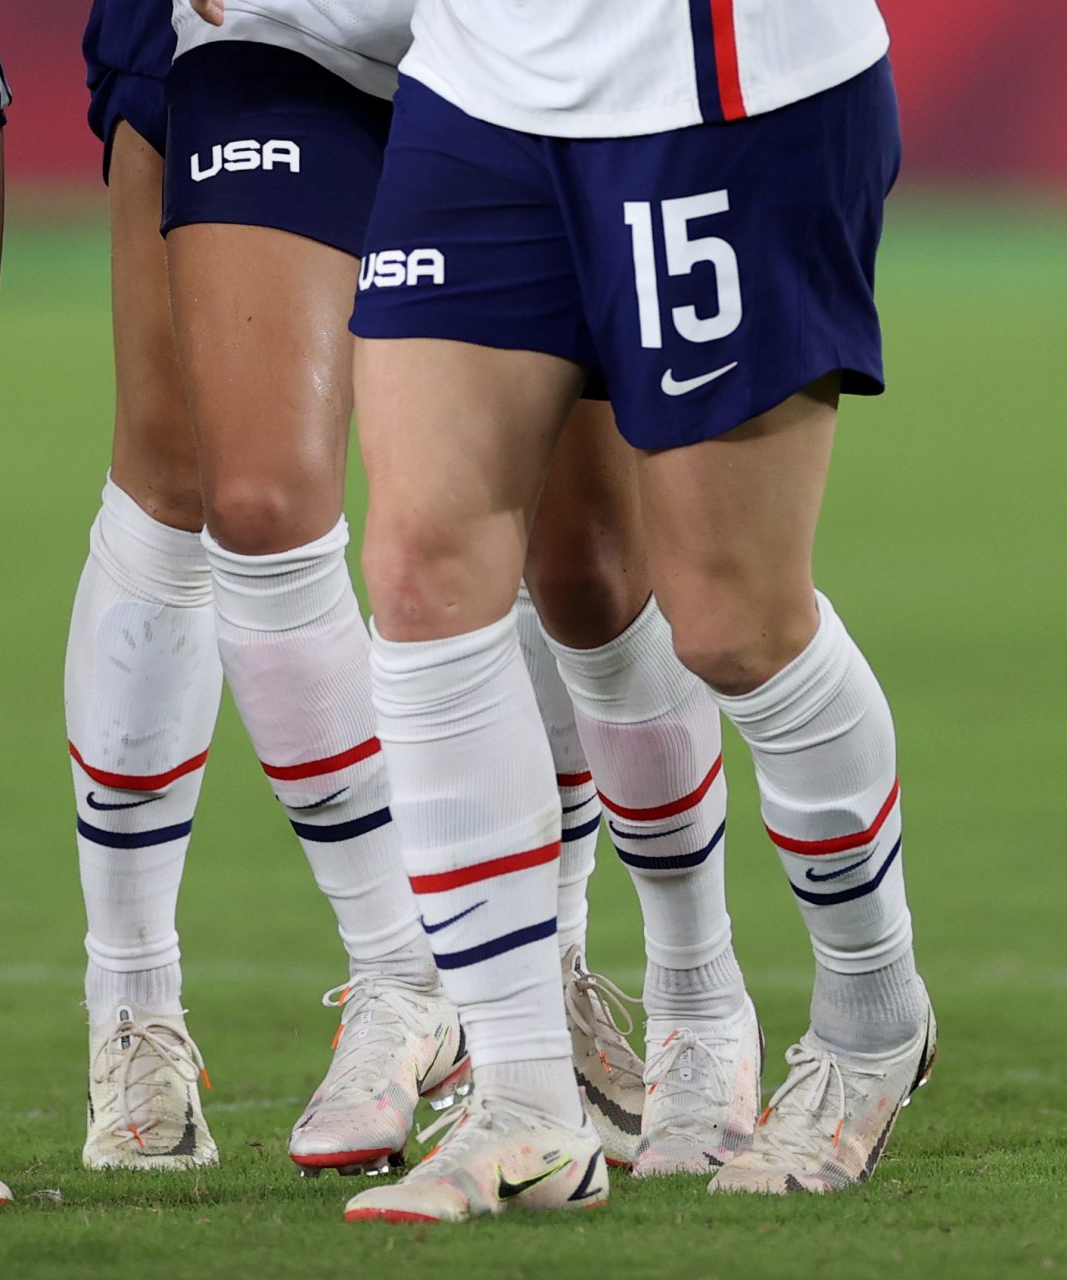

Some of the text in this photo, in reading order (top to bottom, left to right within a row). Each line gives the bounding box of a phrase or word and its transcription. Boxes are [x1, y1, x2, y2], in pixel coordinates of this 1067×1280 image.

[191, 139, 300, 182] USA
[358, 248, 445, 291] USA
[623, 189, 742, 349] 15
